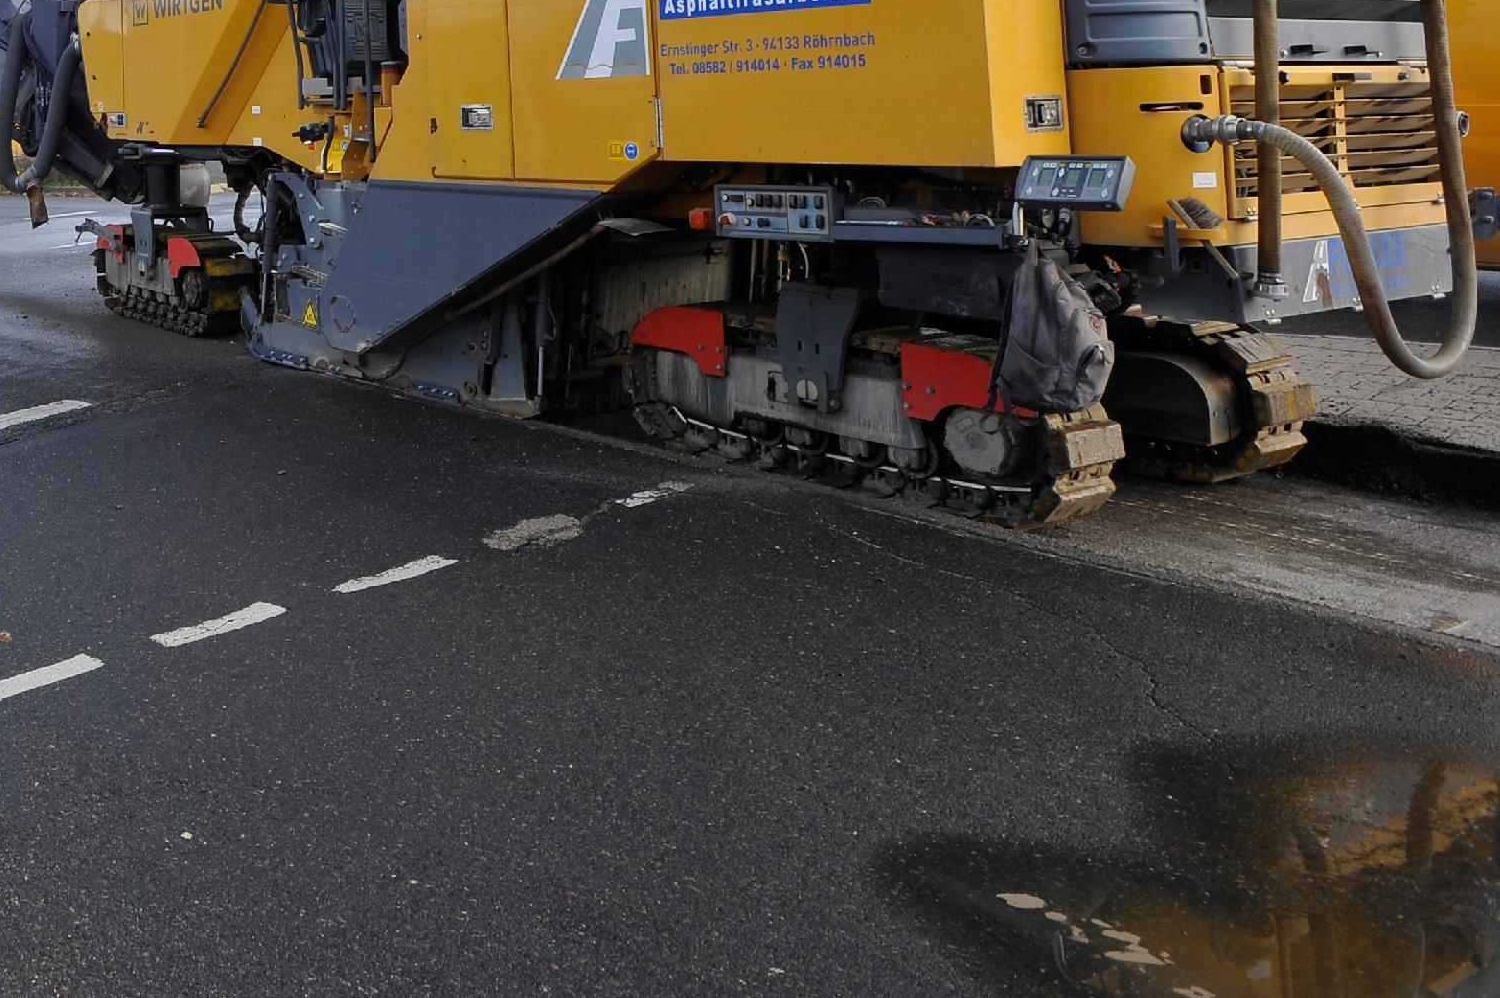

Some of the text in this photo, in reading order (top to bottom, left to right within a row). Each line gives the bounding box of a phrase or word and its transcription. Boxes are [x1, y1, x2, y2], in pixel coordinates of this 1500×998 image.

[661, 42, 719, 57] Ernstinger
[722, 40, 742, 53] Str.
[746, 38, 754, 52] 3
[763, 36, 800, 50] 94133
[803, 32, 875, 48] Röhrnbach
[670, 62, 689, 74] Tel.
[692, 61, 726, 74] 08582
[736, 58, 780, 72] 914014
[791, 57, 814, 70] Fax
[817, 54, 867, 69] 914015
